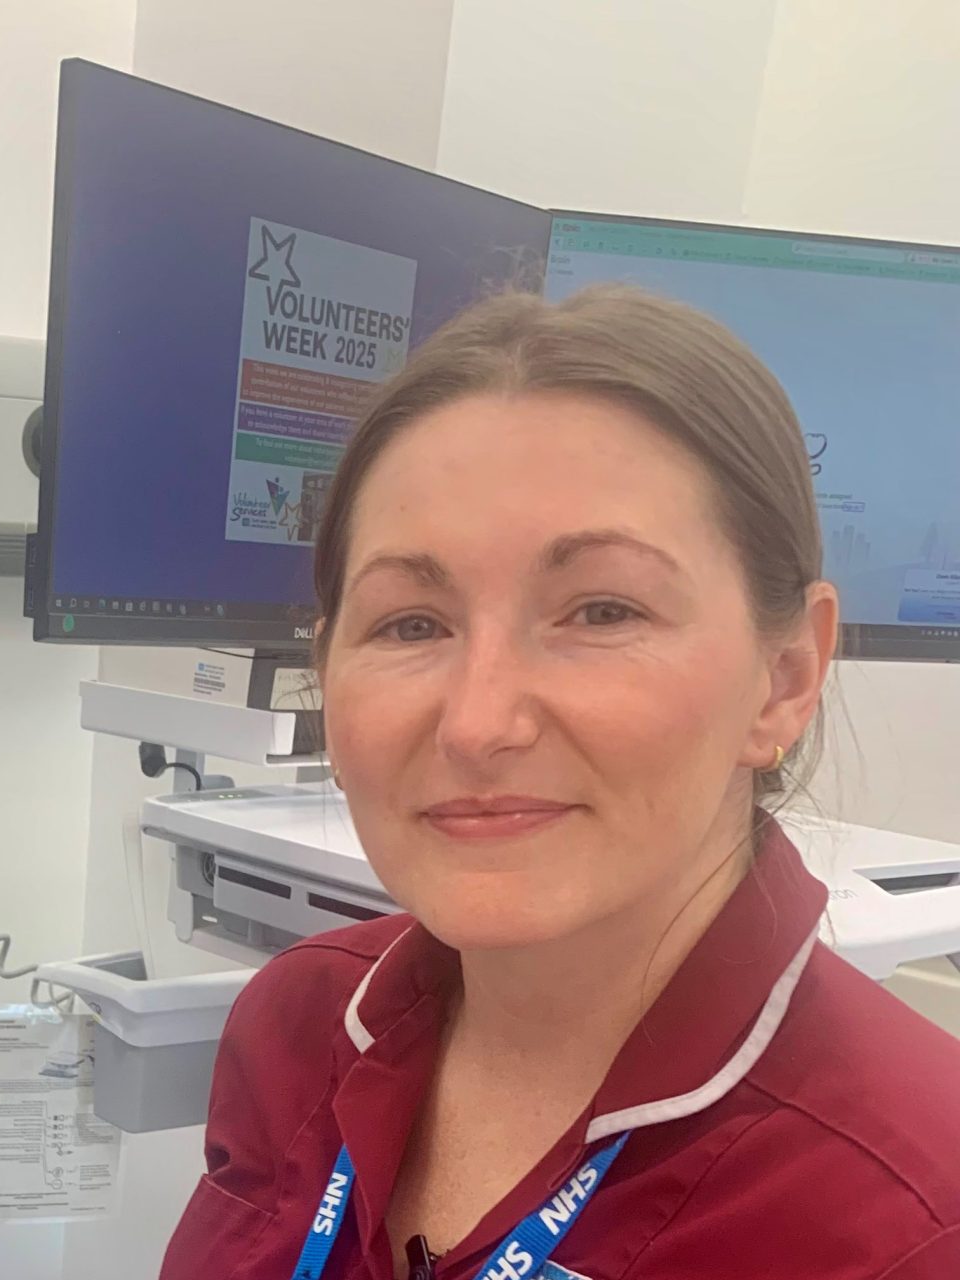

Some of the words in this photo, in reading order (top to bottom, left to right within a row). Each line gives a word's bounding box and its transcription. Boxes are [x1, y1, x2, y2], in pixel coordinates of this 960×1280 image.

[266, 283, 410, 343] VOLUNTEERS'
[262, 320, 328, 361] WEEK
[334, 336, 377, 369] 2025
[294, 627, 314, 639] DELL
[313, 1172, 348, 1236] NHS
[539, 1163, 598, 1236] NHS
